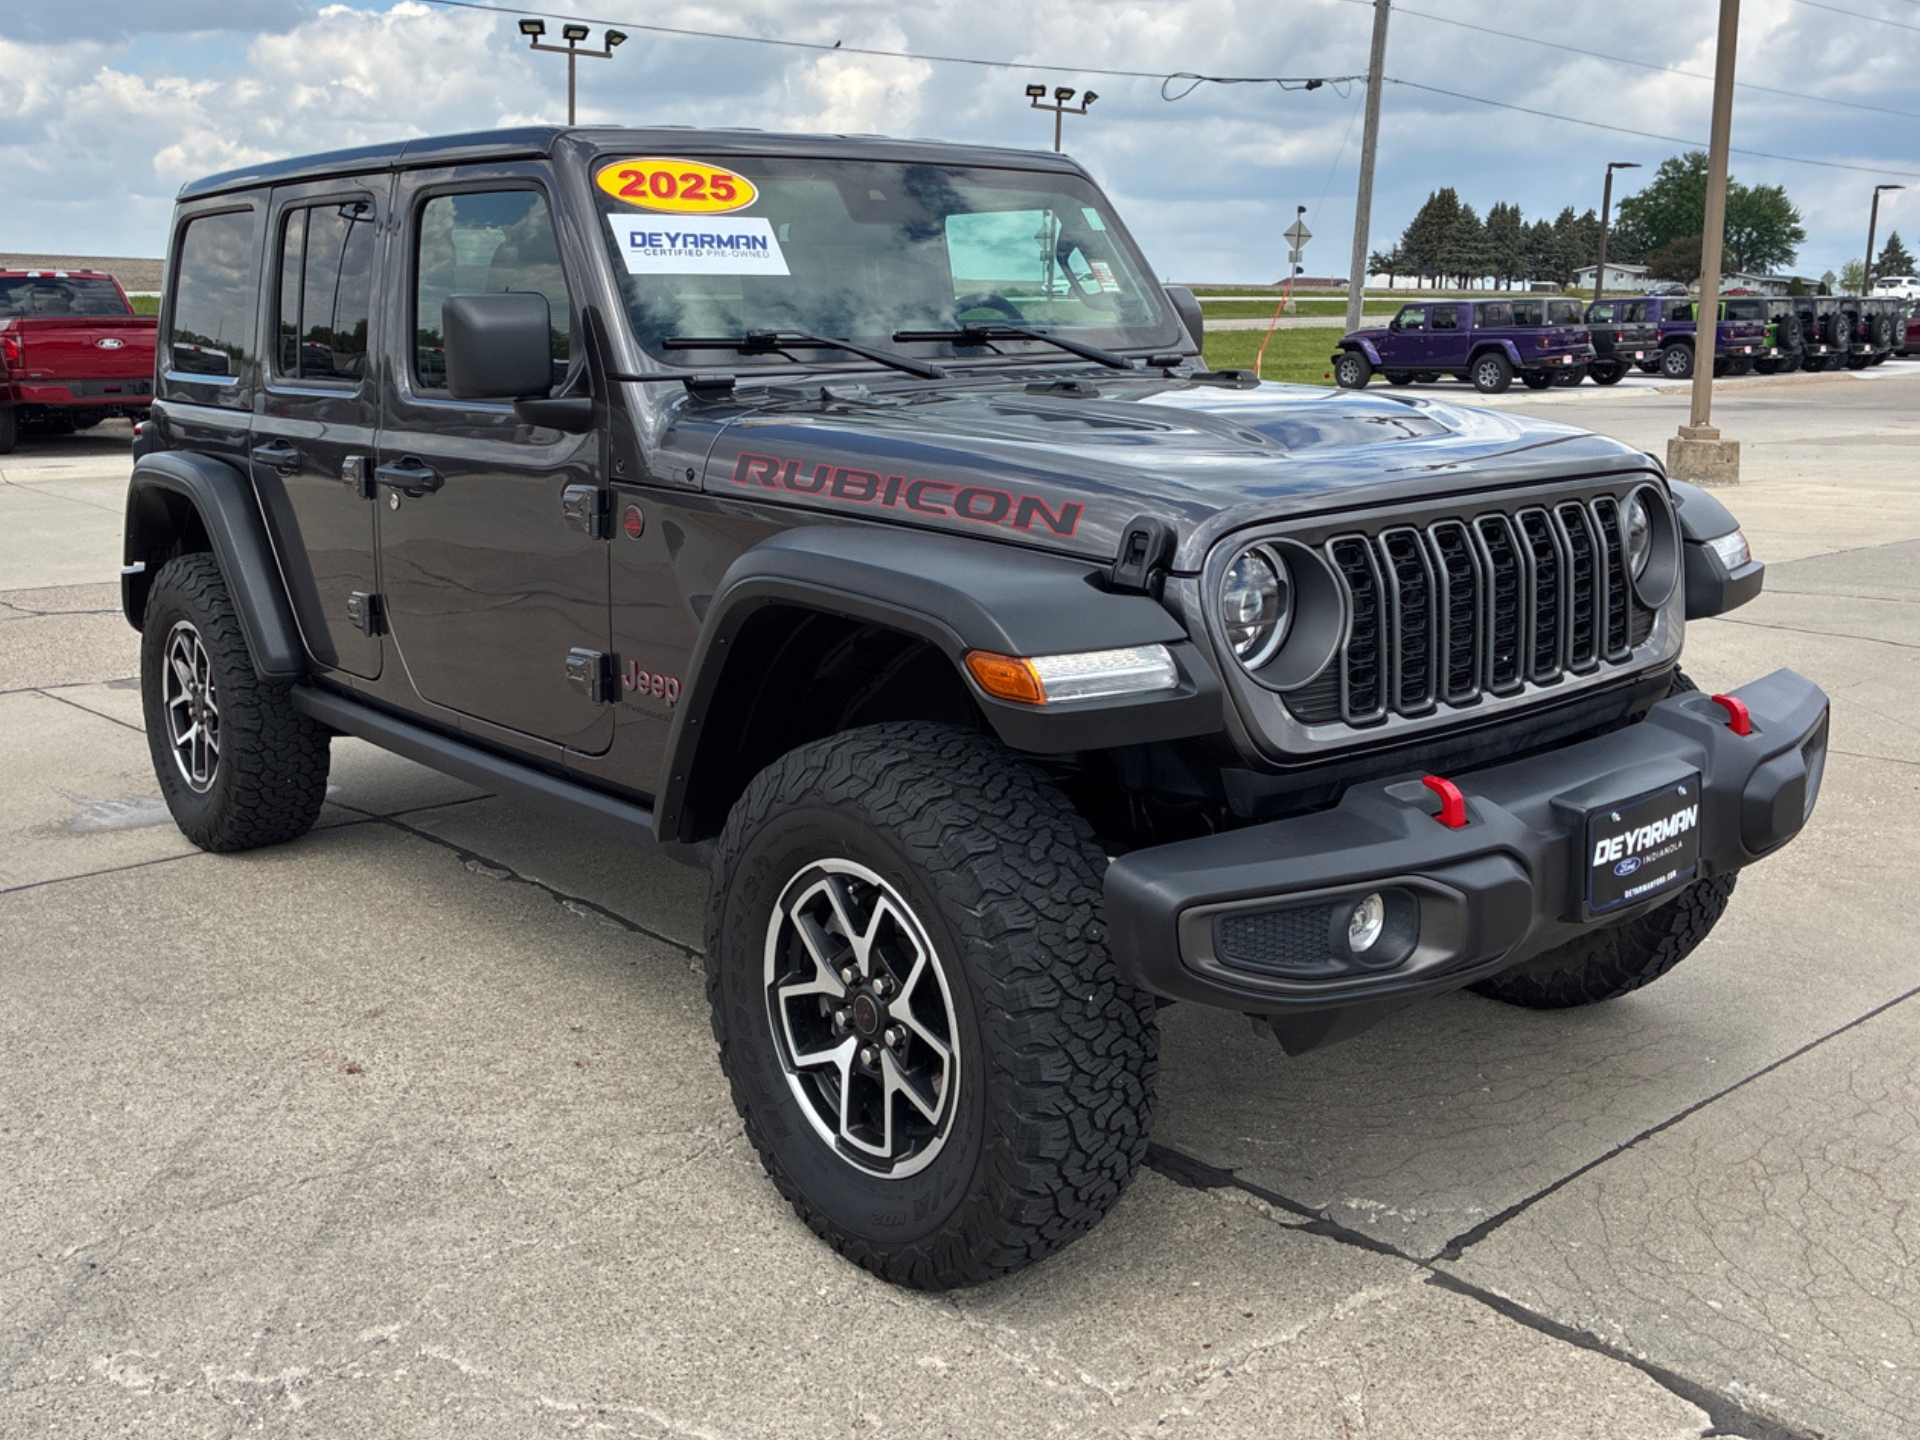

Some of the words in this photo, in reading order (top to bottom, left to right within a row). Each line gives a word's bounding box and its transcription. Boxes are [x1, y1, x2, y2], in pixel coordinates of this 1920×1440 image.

[618, 169, 737, 201] 2025
[630, 231, 768, 250] DEYARMAN
[644, 248, 703, 258] CERTIFIED
[706, 250, 770, 259] PRE-OWNED
[733, 452, 1086, 538] RUBICON
[621, 660, 682, 708] Jeep
[1593, 804, 1698, 866] DEYARMAN
[1643, 841, 1683, 864] INDIANOLA
